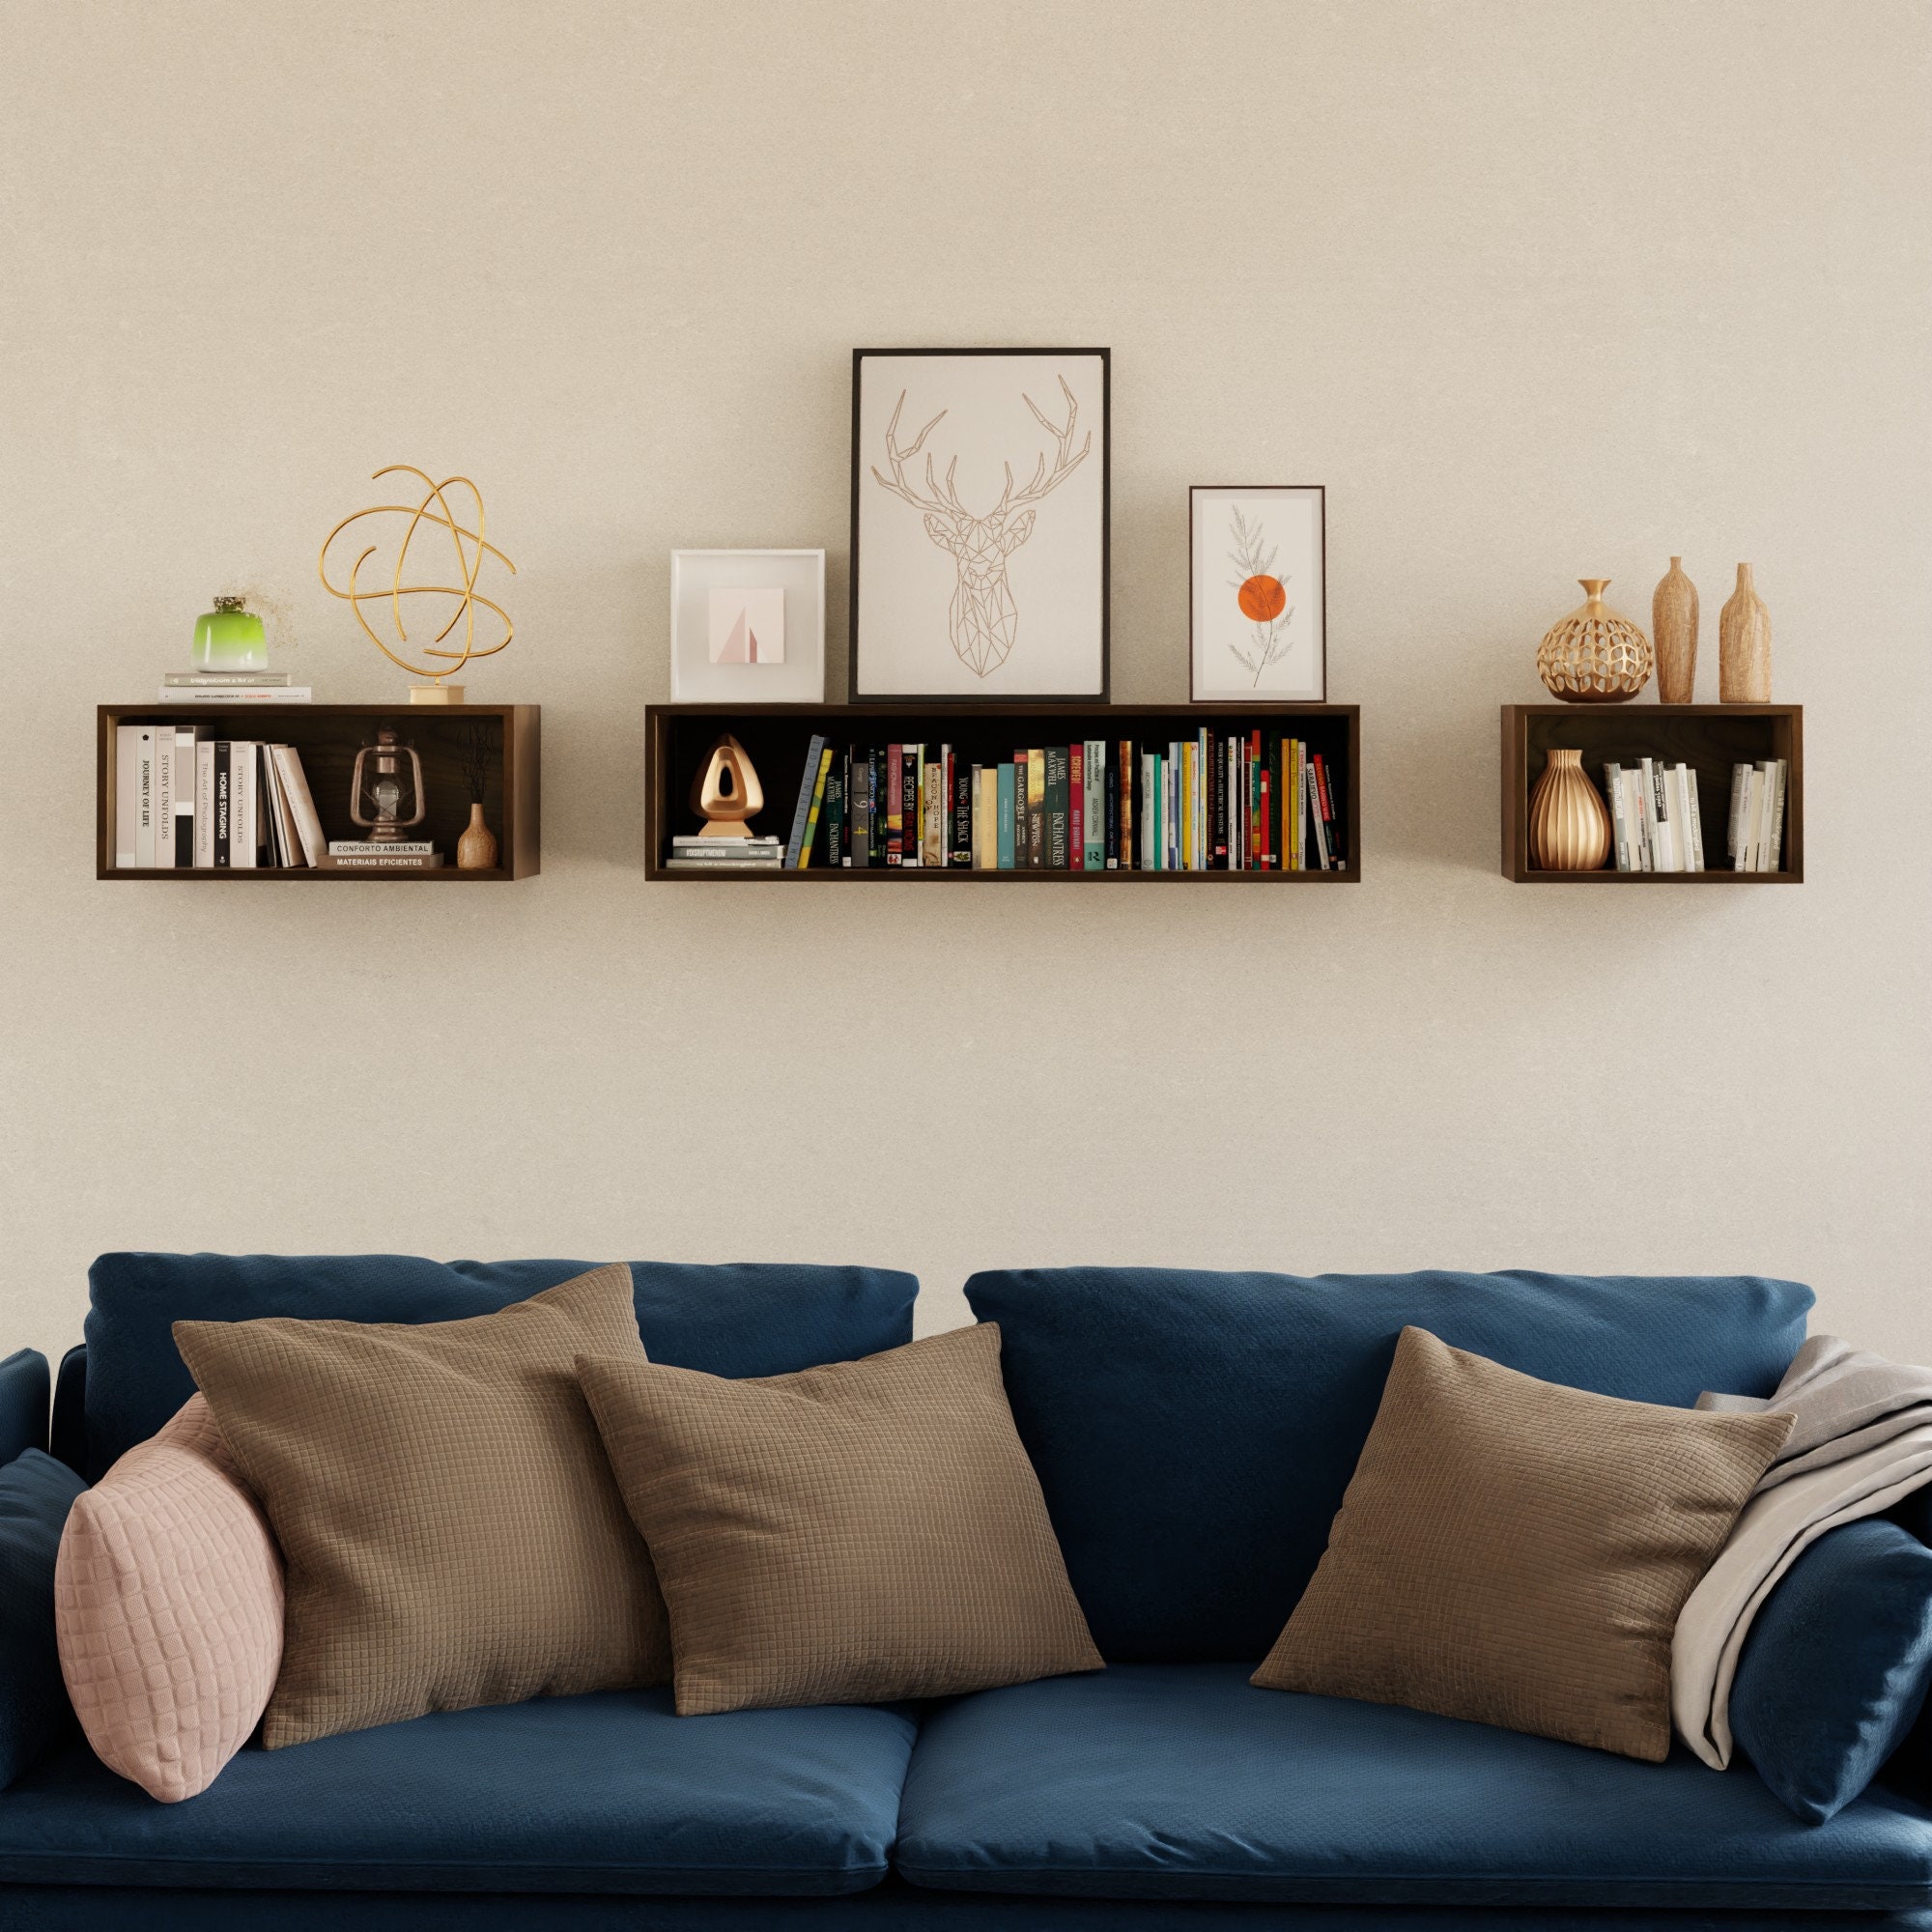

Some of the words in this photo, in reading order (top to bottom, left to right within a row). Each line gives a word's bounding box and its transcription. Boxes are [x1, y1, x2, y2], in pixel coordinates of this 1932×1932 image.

[1057, 758, 1065, 780] JAMES
[1071, 755, 1082, 783] SCREWED!
[904, 777, 914, 801] RECIPES
[959, 778, 969, 799] YOUNG
[1307, 768, 1317, 800] SARAJEVO
[143, 799, 149, 809] OF
[957, 806, 969, 818] THE
[904, 812, 914, 827] REAL
[904, 830, 914, 850] MOMS
[957, 821, 969, 843] SHACK
[1052, 813, 1065, 866] ENCHANTRESS
[1772, 813, 1781, 850] mockingbird
[830, 823, 838, 864] ENCHANTRESS
